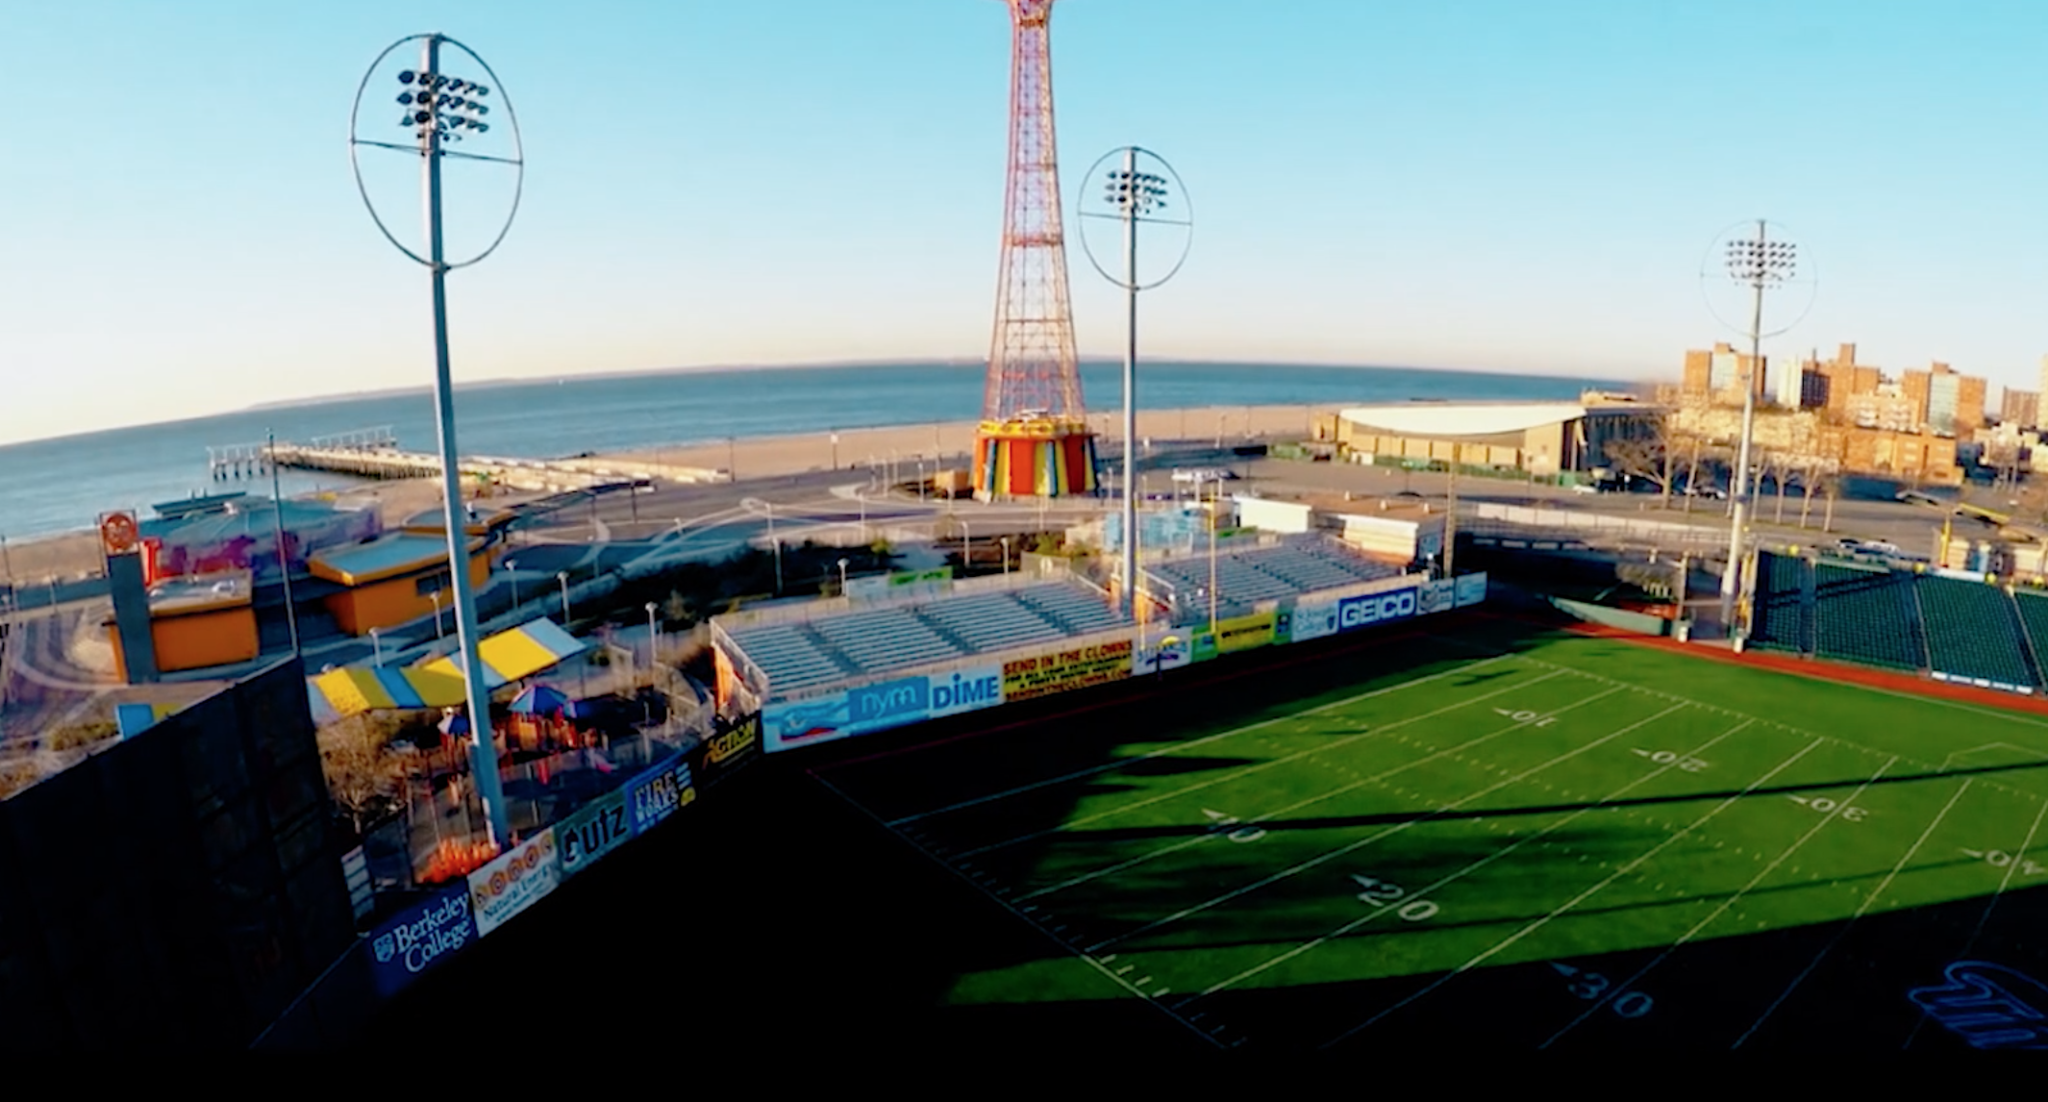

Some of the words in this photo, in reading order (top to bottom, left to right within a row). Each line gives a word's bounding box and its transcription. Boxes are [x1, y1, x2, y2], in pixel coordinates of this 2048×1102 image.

[1341, 592, 1416, 628] GEICO
[1003, 660, 1036, 676] SEND
[1041, 656, 1054, 668] IN
[1059, 651, 1080, 664] THE
[1085, 641, 1132, 659] CLOWNS
[1511, 709, 1558, 728] 10
[702, 718, 759, 771] ACTION
[1651, 750, 1710, 773] 20
[635, 771, 677, 808] FIRE
[635, 792, 680, 823] WORKS
[1811, 797, 1869, 823] 30
[1357, 882, 1440, 922] 20
[393, 891, 470, 955] Berkeley
[405, 919, 472, 973] College
[1567, 971, 1654, 1019] 30
